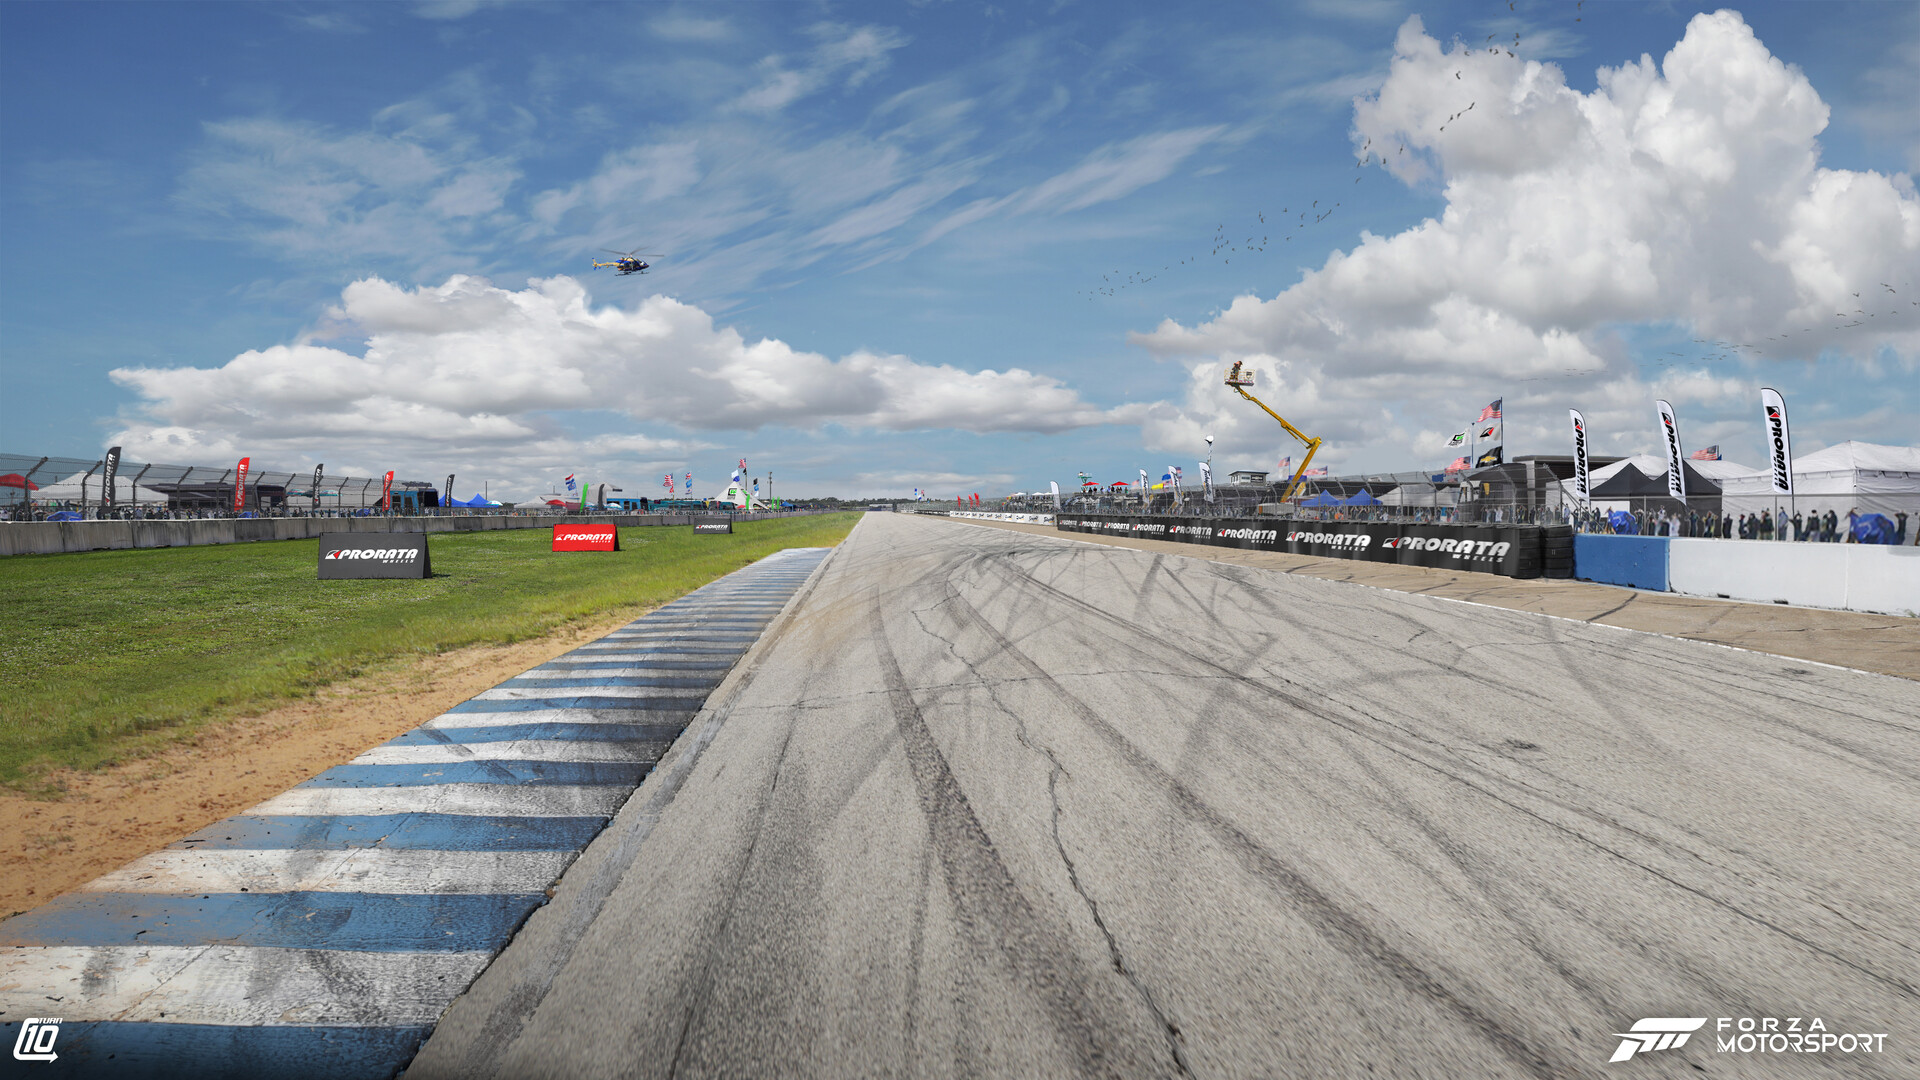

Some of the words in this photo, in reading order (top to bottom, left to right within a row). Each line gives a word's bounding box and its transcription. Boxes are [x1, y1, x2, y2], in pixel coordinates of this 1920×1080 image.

[1575, 429, 1587, 494] PRORATA
[1665, 424, 1682, 494] PRORATA
[1769, 417, 1789, 490] PRORATA
[106, 453, 114, 500] PRORATA
[237, 464, 245, 500] PRORATA
[1108, 522, 1130, 530] PRORATA
[1137, 523, 1165, 532] PRORATA
[1174, 525, 1212, 536] PRORATA
[1224, 528, 1277, 540] PRORATA
[1294, 531, 1371, 547] PRORATA
[1396, 536, 1511, 556] PRORATA
[338, 548, 418, 559] PRORATA
